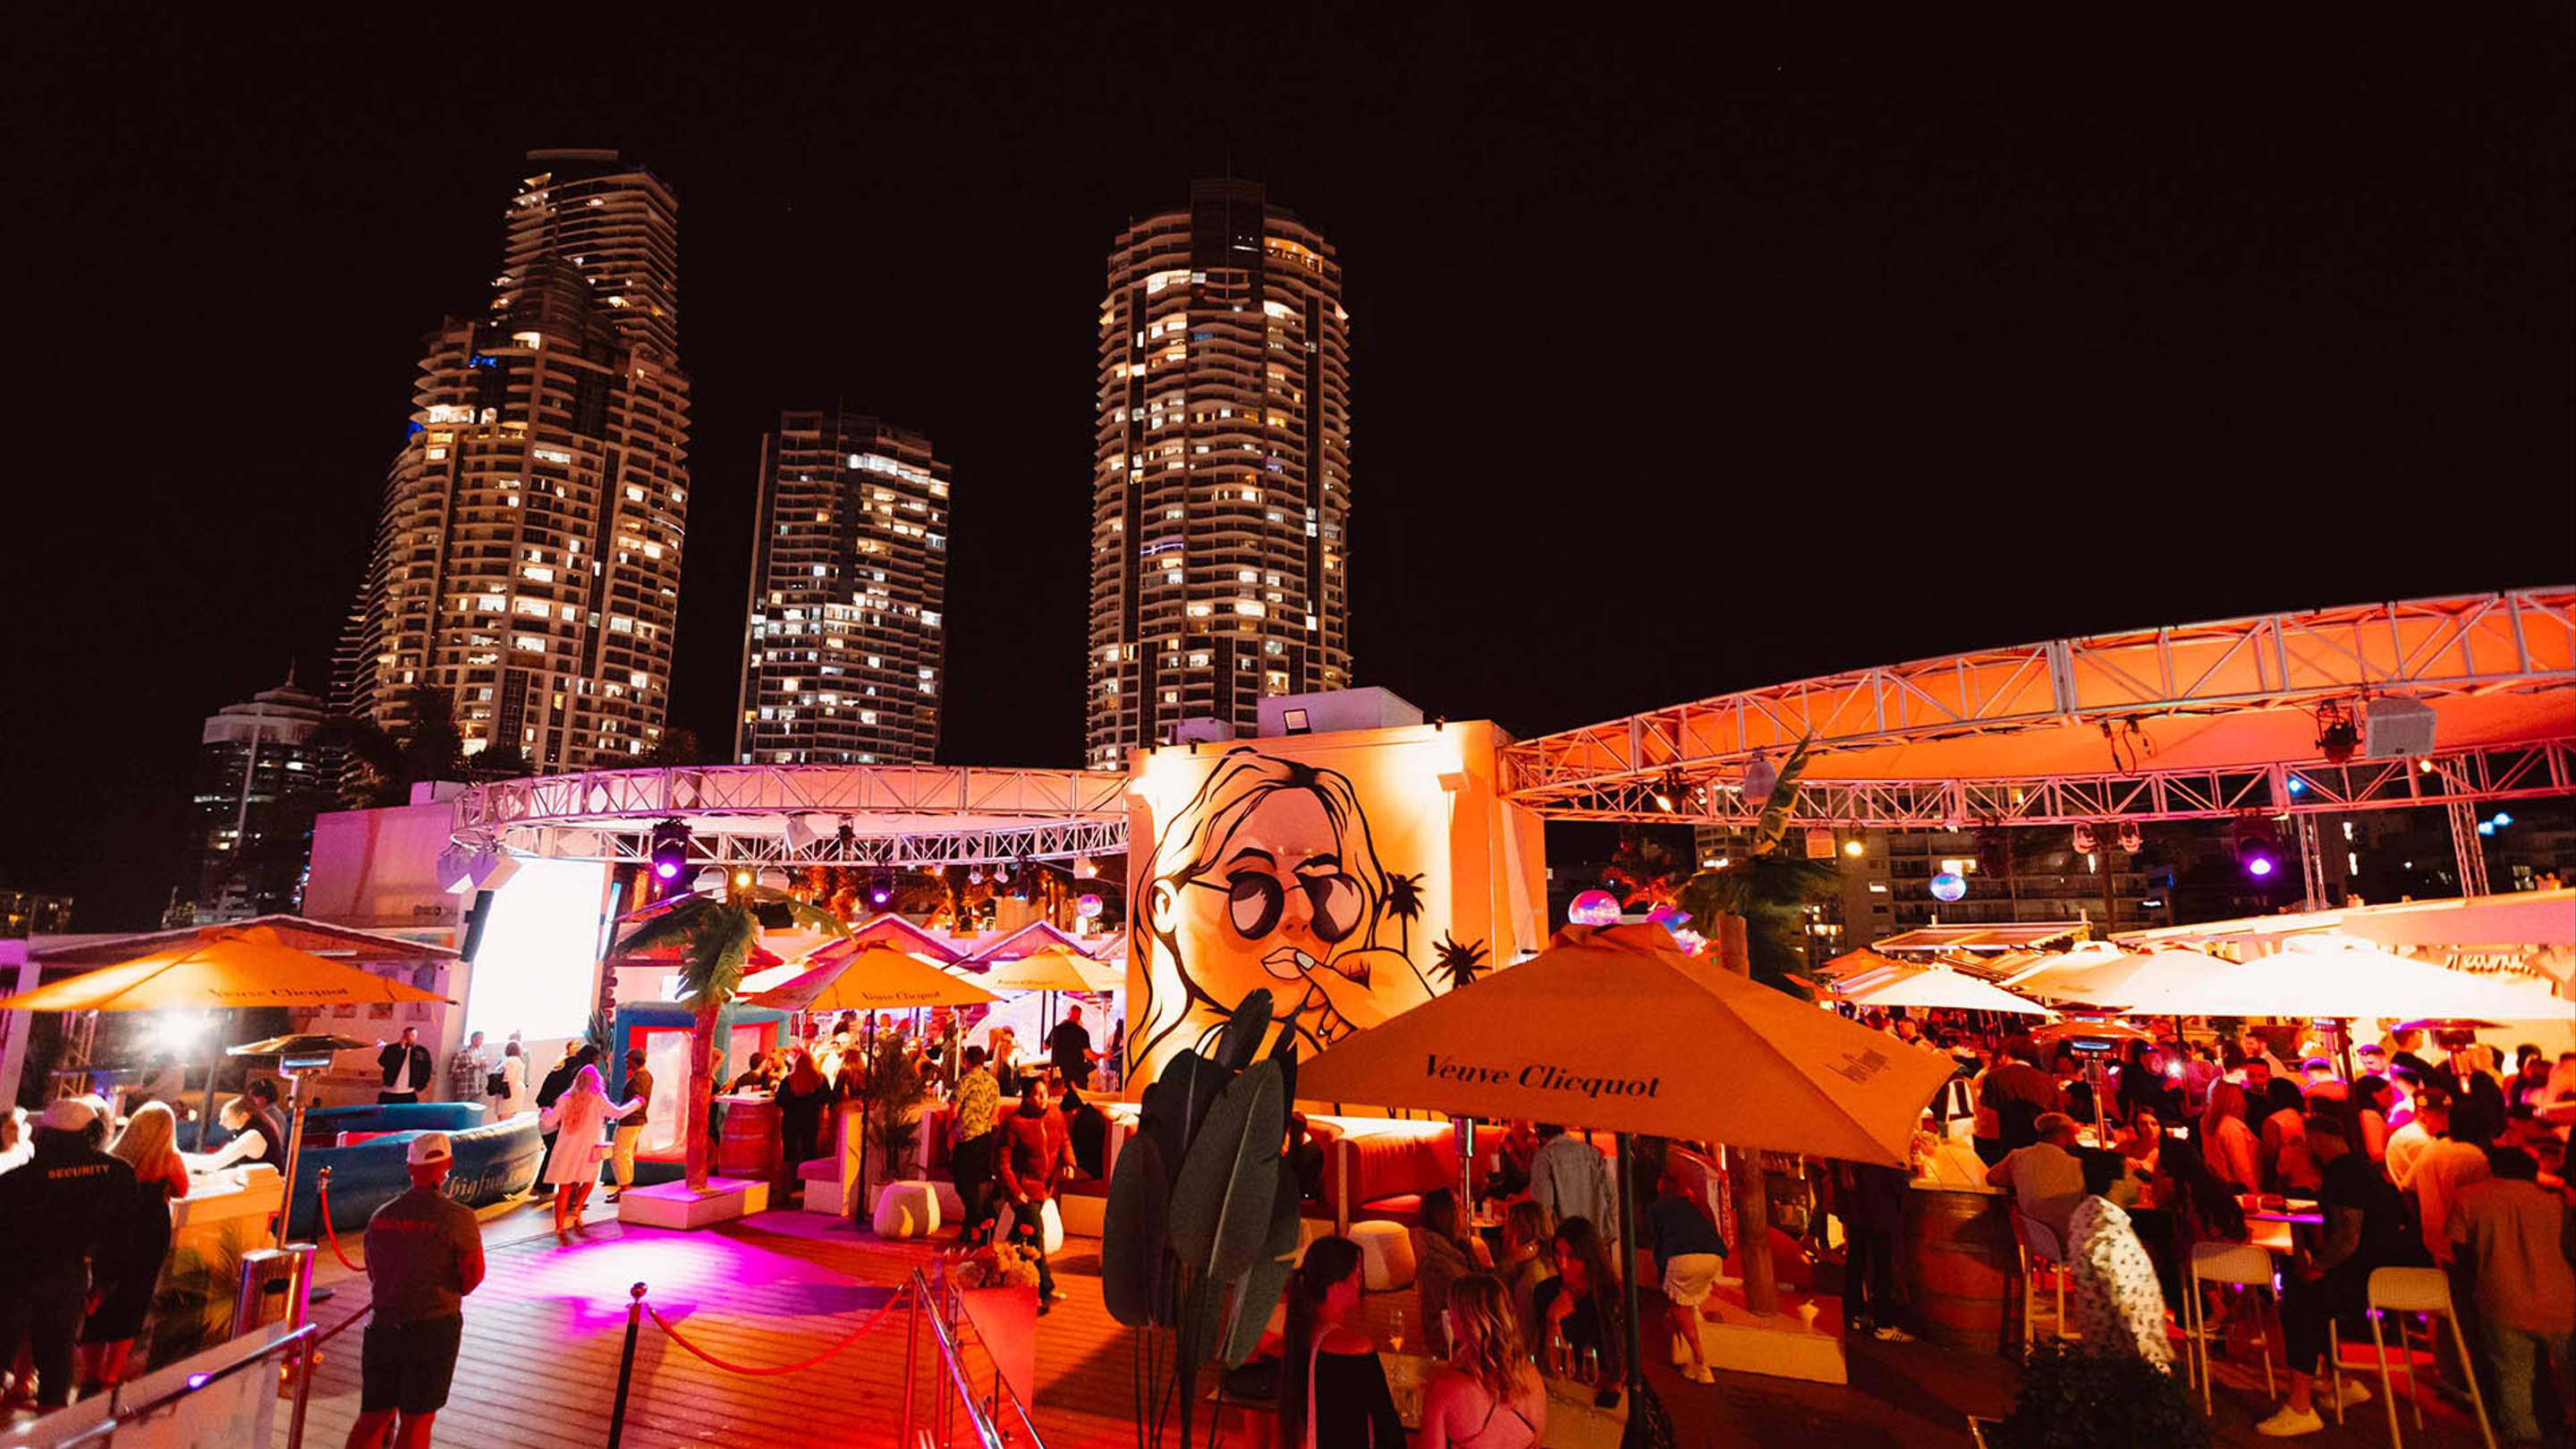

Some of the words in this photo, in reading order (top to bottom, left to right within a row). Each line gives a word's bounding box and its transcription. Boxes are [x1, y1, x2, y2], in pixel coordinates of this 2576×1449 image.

[1426, 1054, 1510, 1084] Veuve
[1518, 1064, 1659, 1098] Clicquot
[47, 1164, 110, 1180] SECURITY
